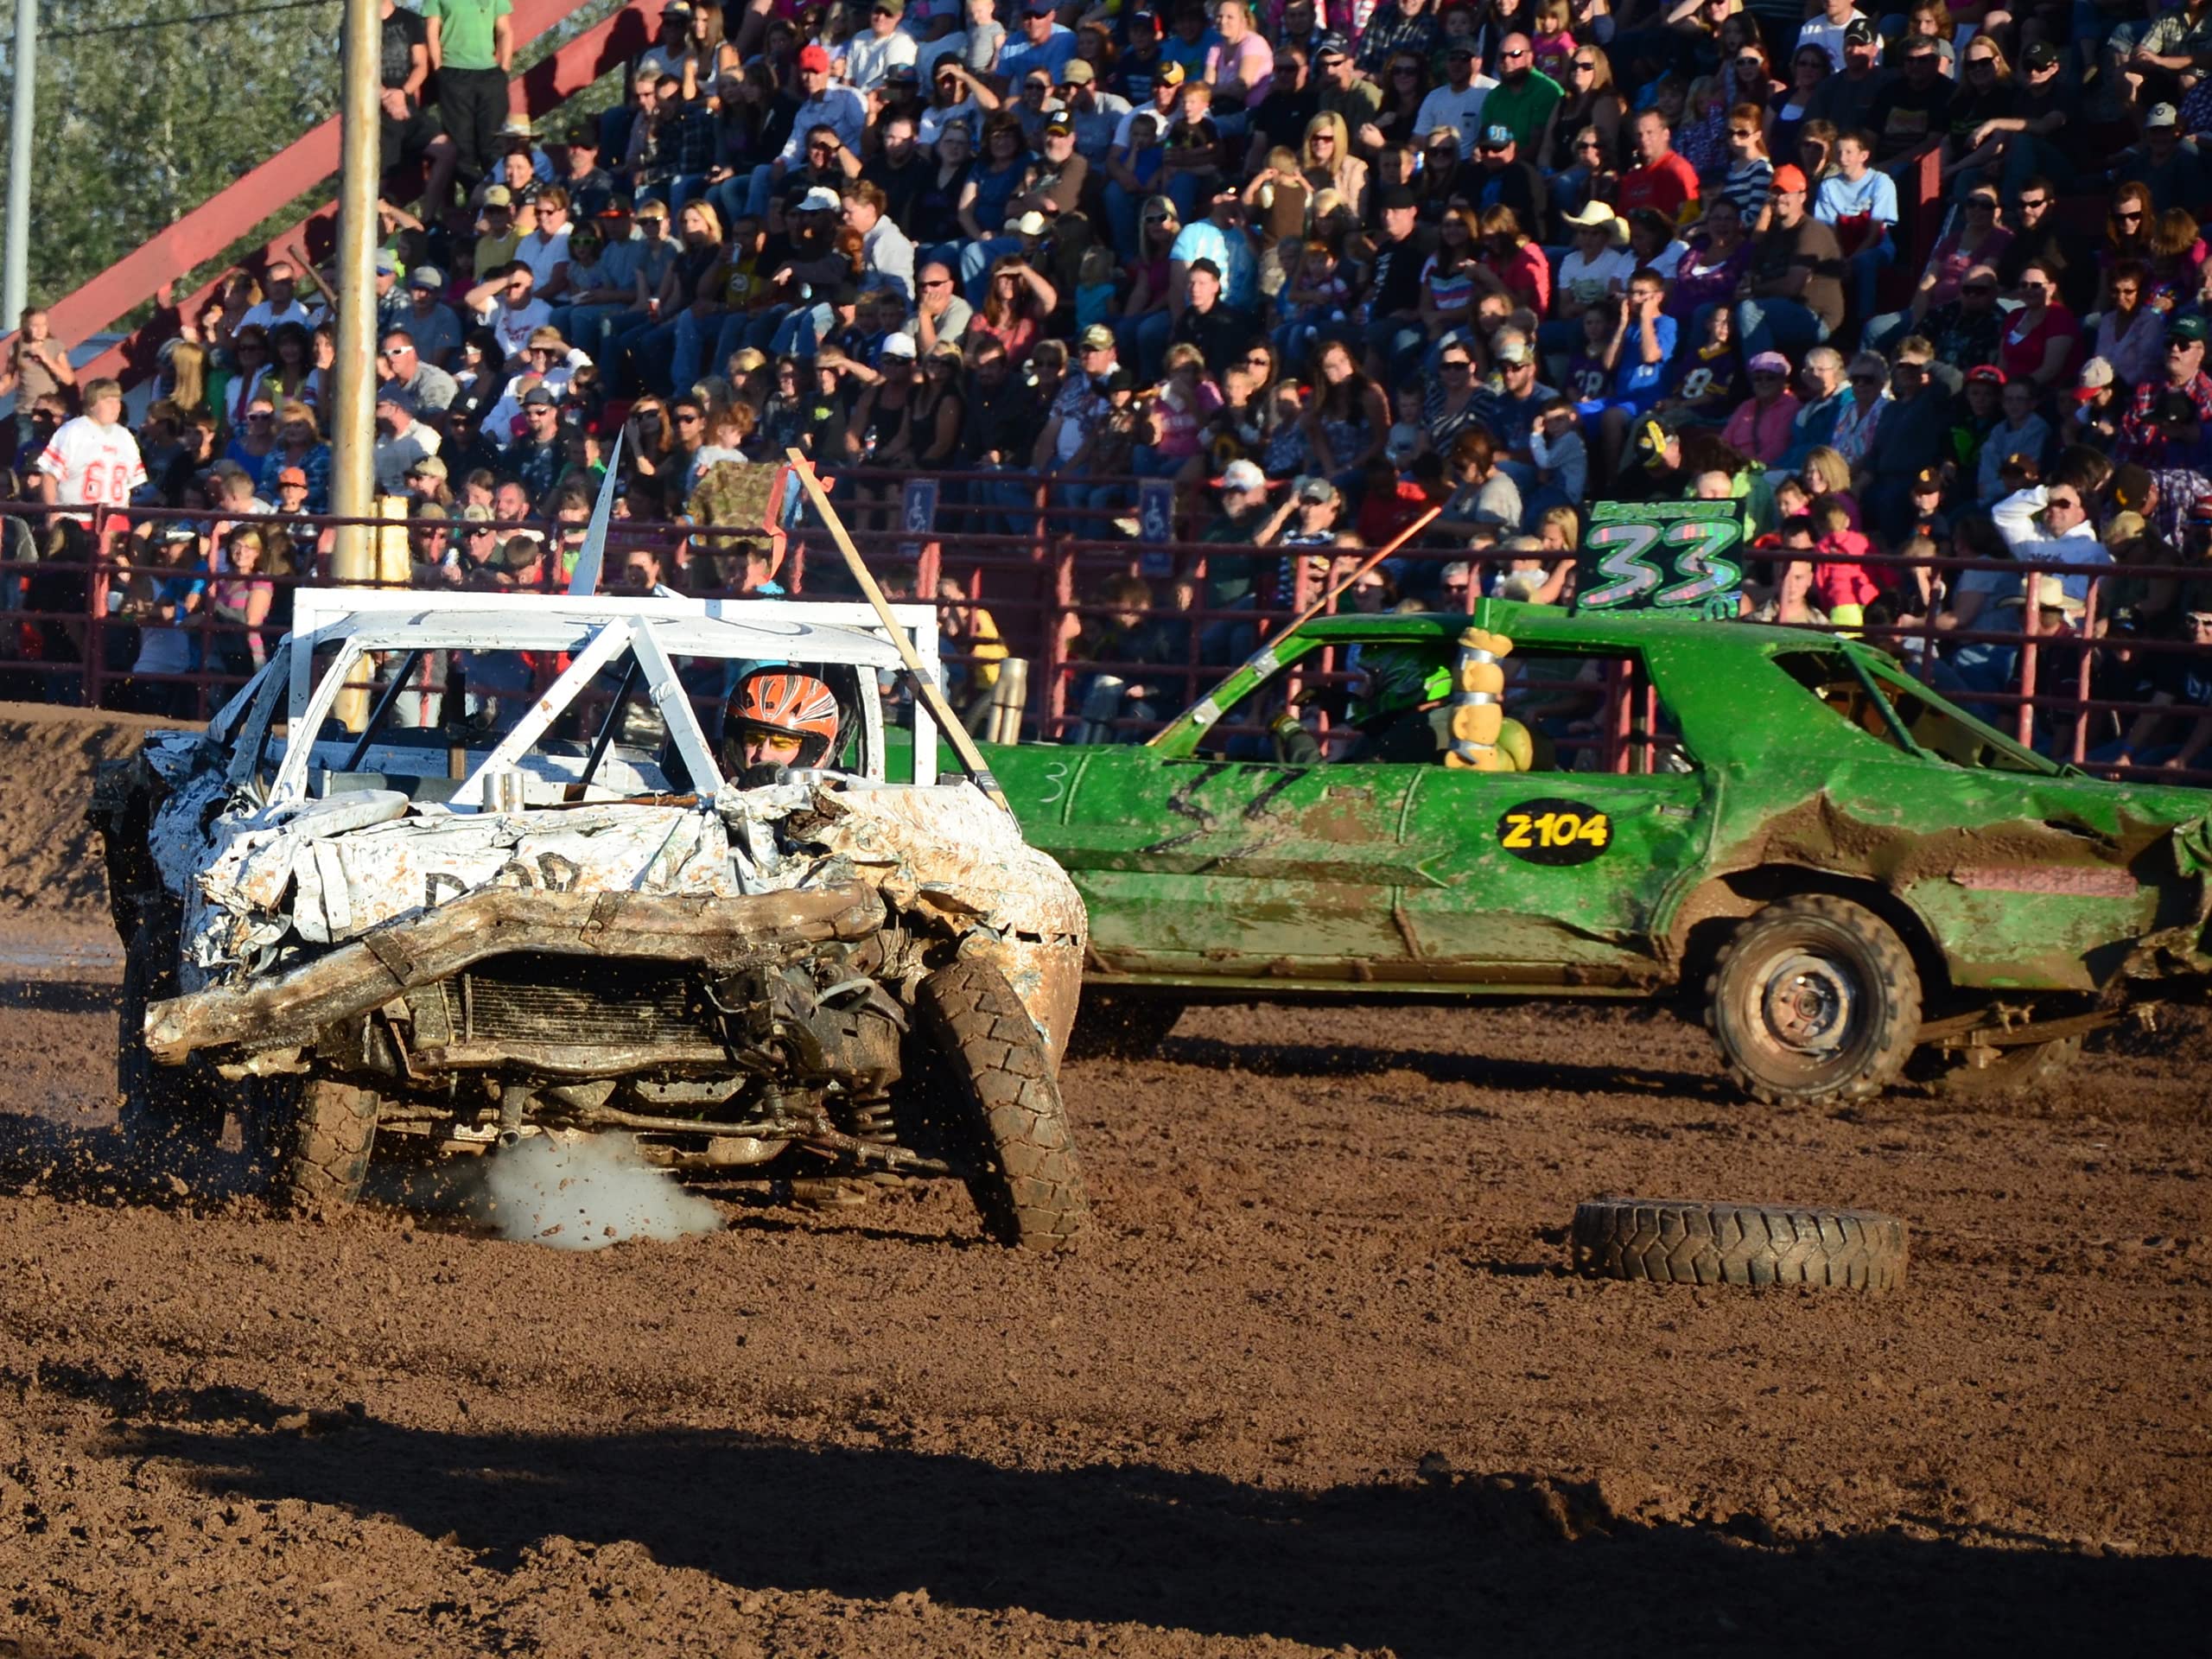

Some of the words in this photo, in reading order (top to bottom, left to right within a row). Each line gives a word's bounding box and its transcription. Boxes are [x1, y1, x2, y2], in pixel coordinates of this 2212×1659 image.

[84, 461, 127, 501] 68
[1578, 518, 1742, 608] 33
[1039, 761, 1068, 803] 3
